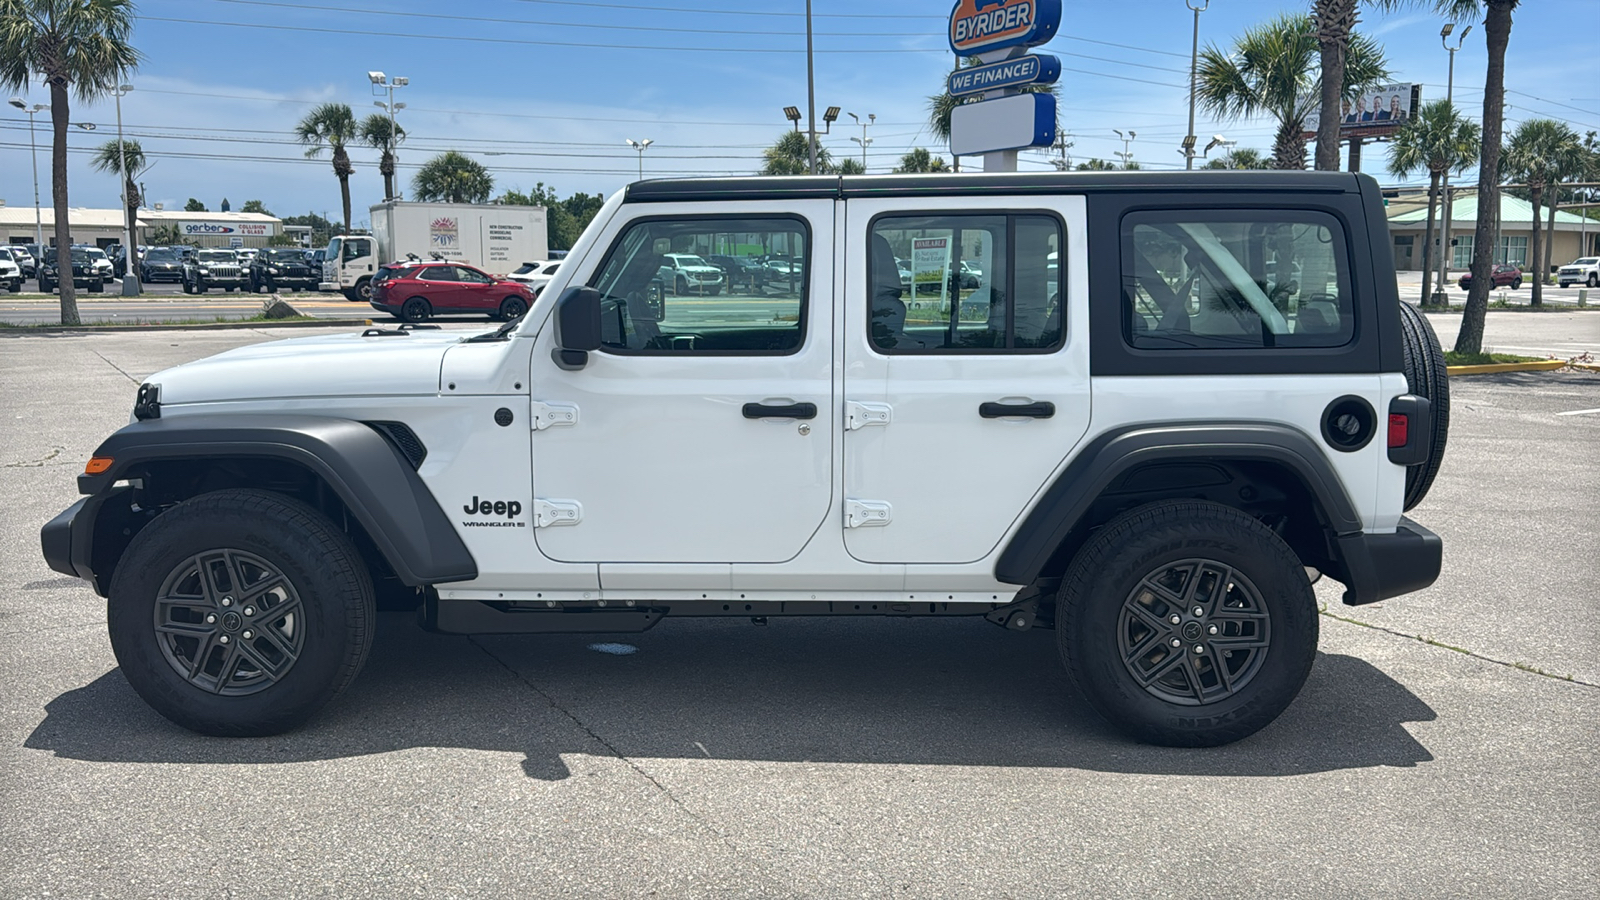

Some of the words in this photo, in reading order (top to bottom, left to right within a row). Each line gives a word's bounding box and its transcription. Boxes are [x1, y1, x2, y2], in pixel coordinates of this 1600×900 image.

[955, 2, 1031, 41] BYRIDER
[953, 75, 971, 89] WE
[973, 61, 1035, 85] FINANCE!
[186, 223, 223, 233] gerber
[916, 240, 945, 248] AVAILABLE
[463, 496, 521, 519] Jeep
